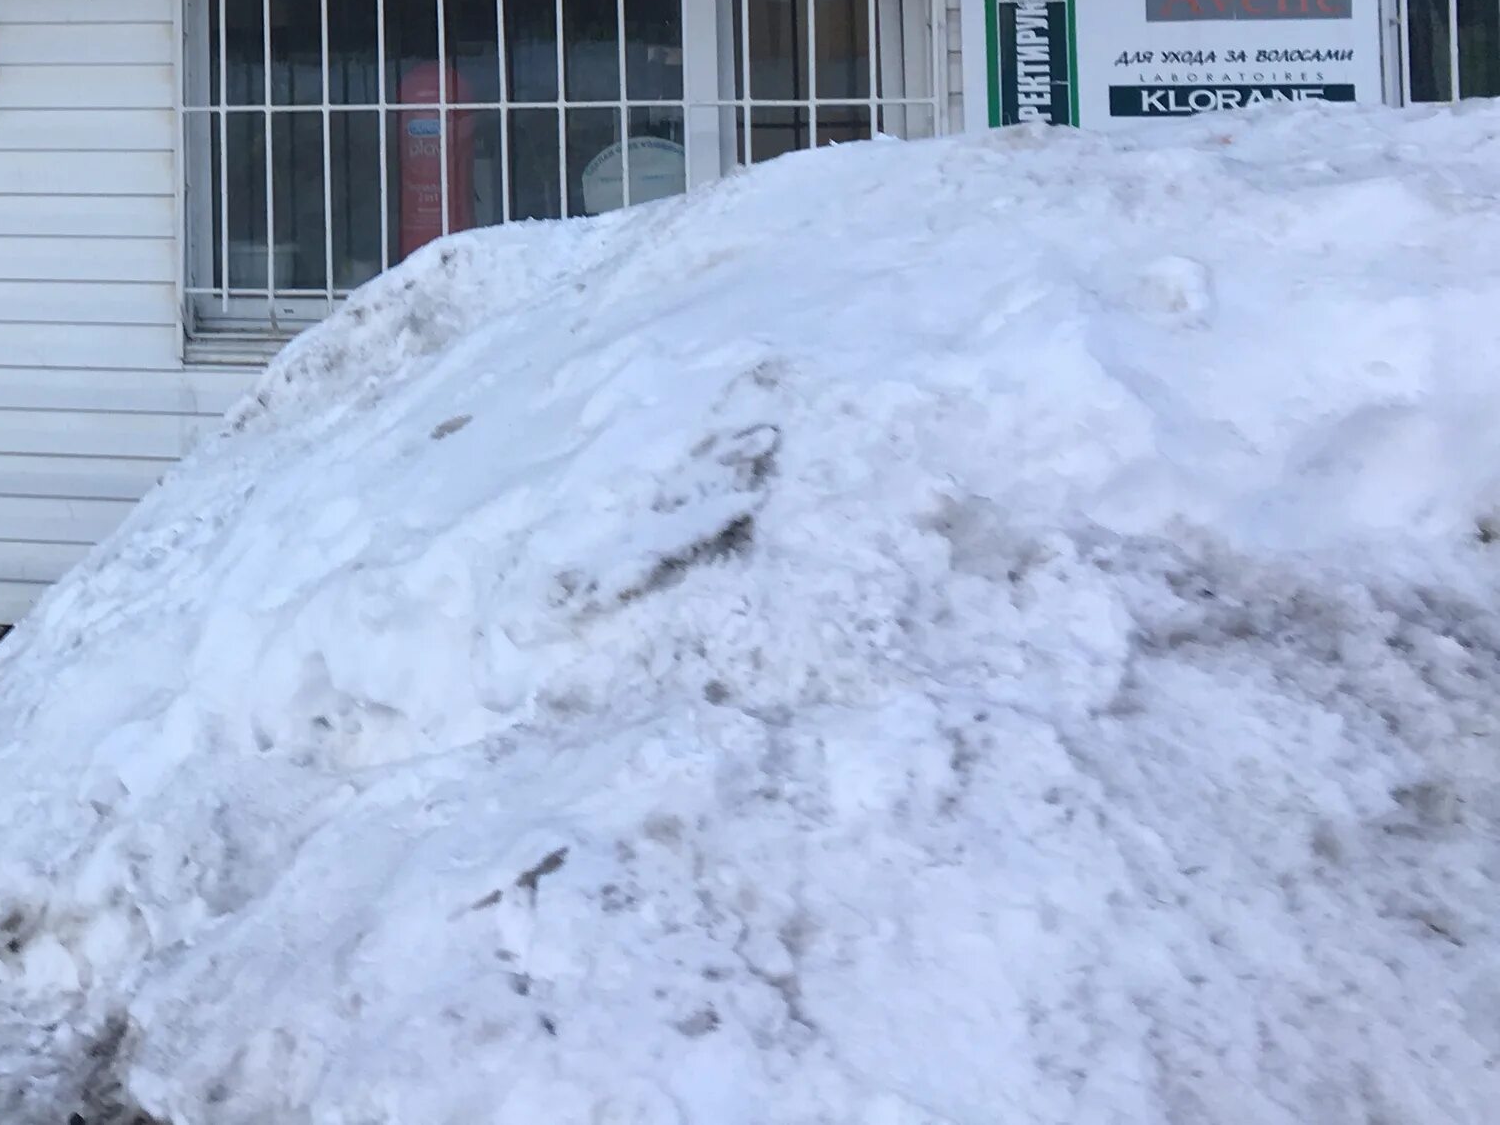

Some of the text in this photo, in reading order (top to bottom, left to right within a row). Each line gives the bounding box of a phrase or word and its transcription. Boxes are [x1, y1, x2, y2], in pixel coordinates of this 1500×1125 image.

[1114, 48, 1354, 66] ДЛЯ УХОДА ЗА ВОЛОСАМИ
[1139, 72, 1325, 83] LABORATOIRES
